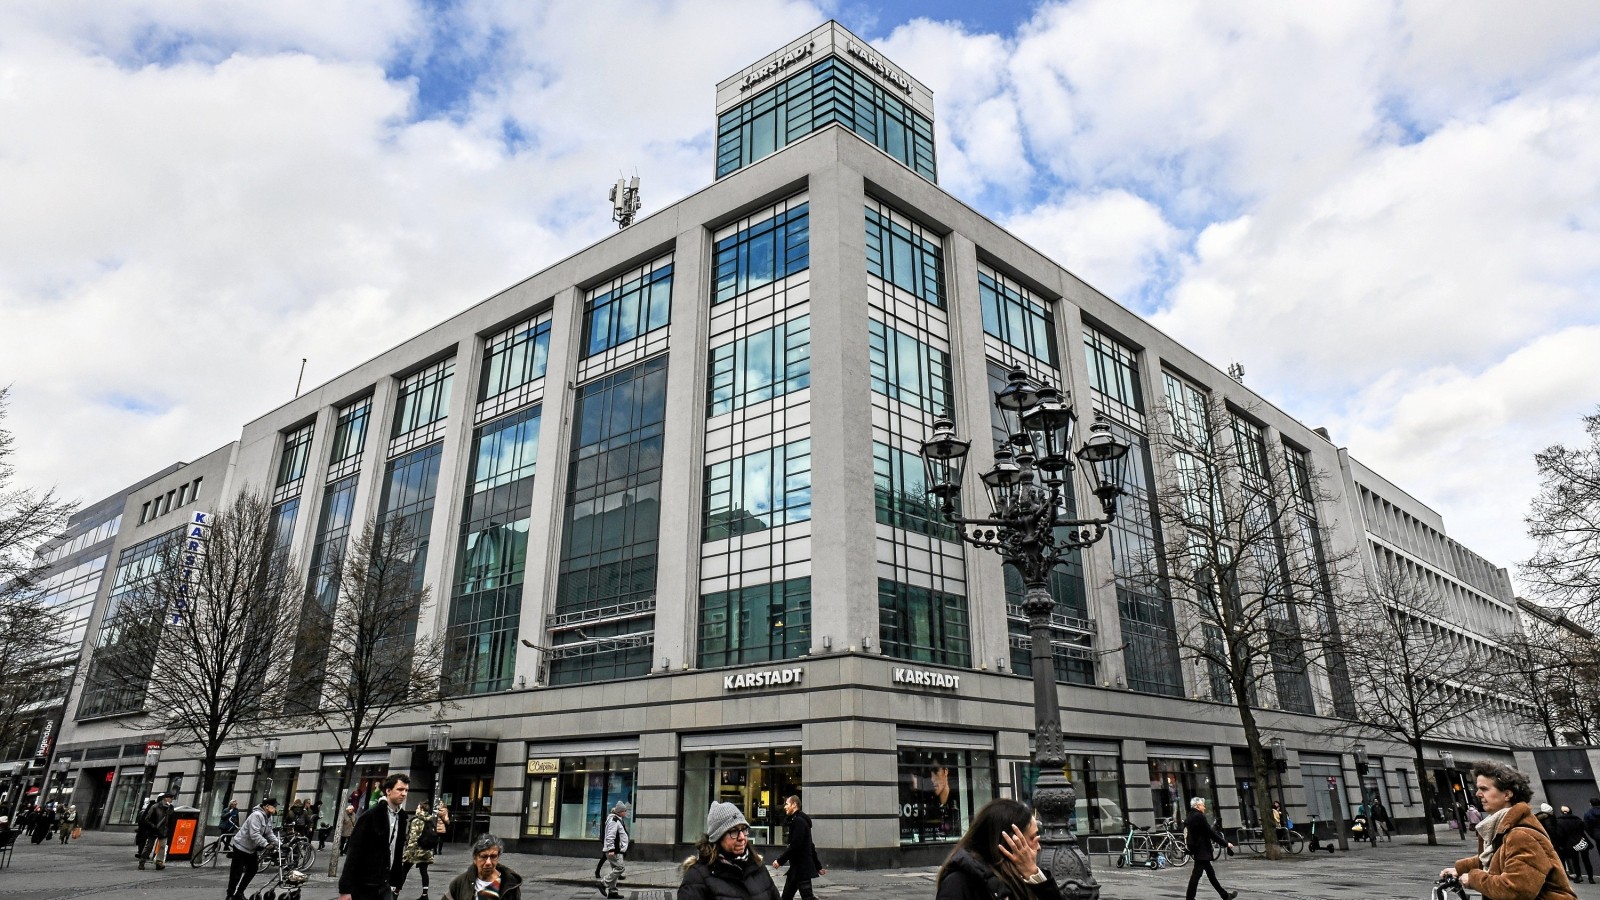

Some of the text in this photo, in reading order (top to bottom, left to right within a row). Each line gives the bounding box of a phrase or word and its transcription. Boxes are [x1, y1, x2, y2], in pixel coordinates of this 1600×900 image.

[739, 41, 814, 92] KARSTADT
[847, 41, 913, 95] KARSTADT
[723, 667, 804, 690] KARSTADT
[892, 666, 960, 690] KARSTADT
[454, 756, 487, 766] KARSTADT
